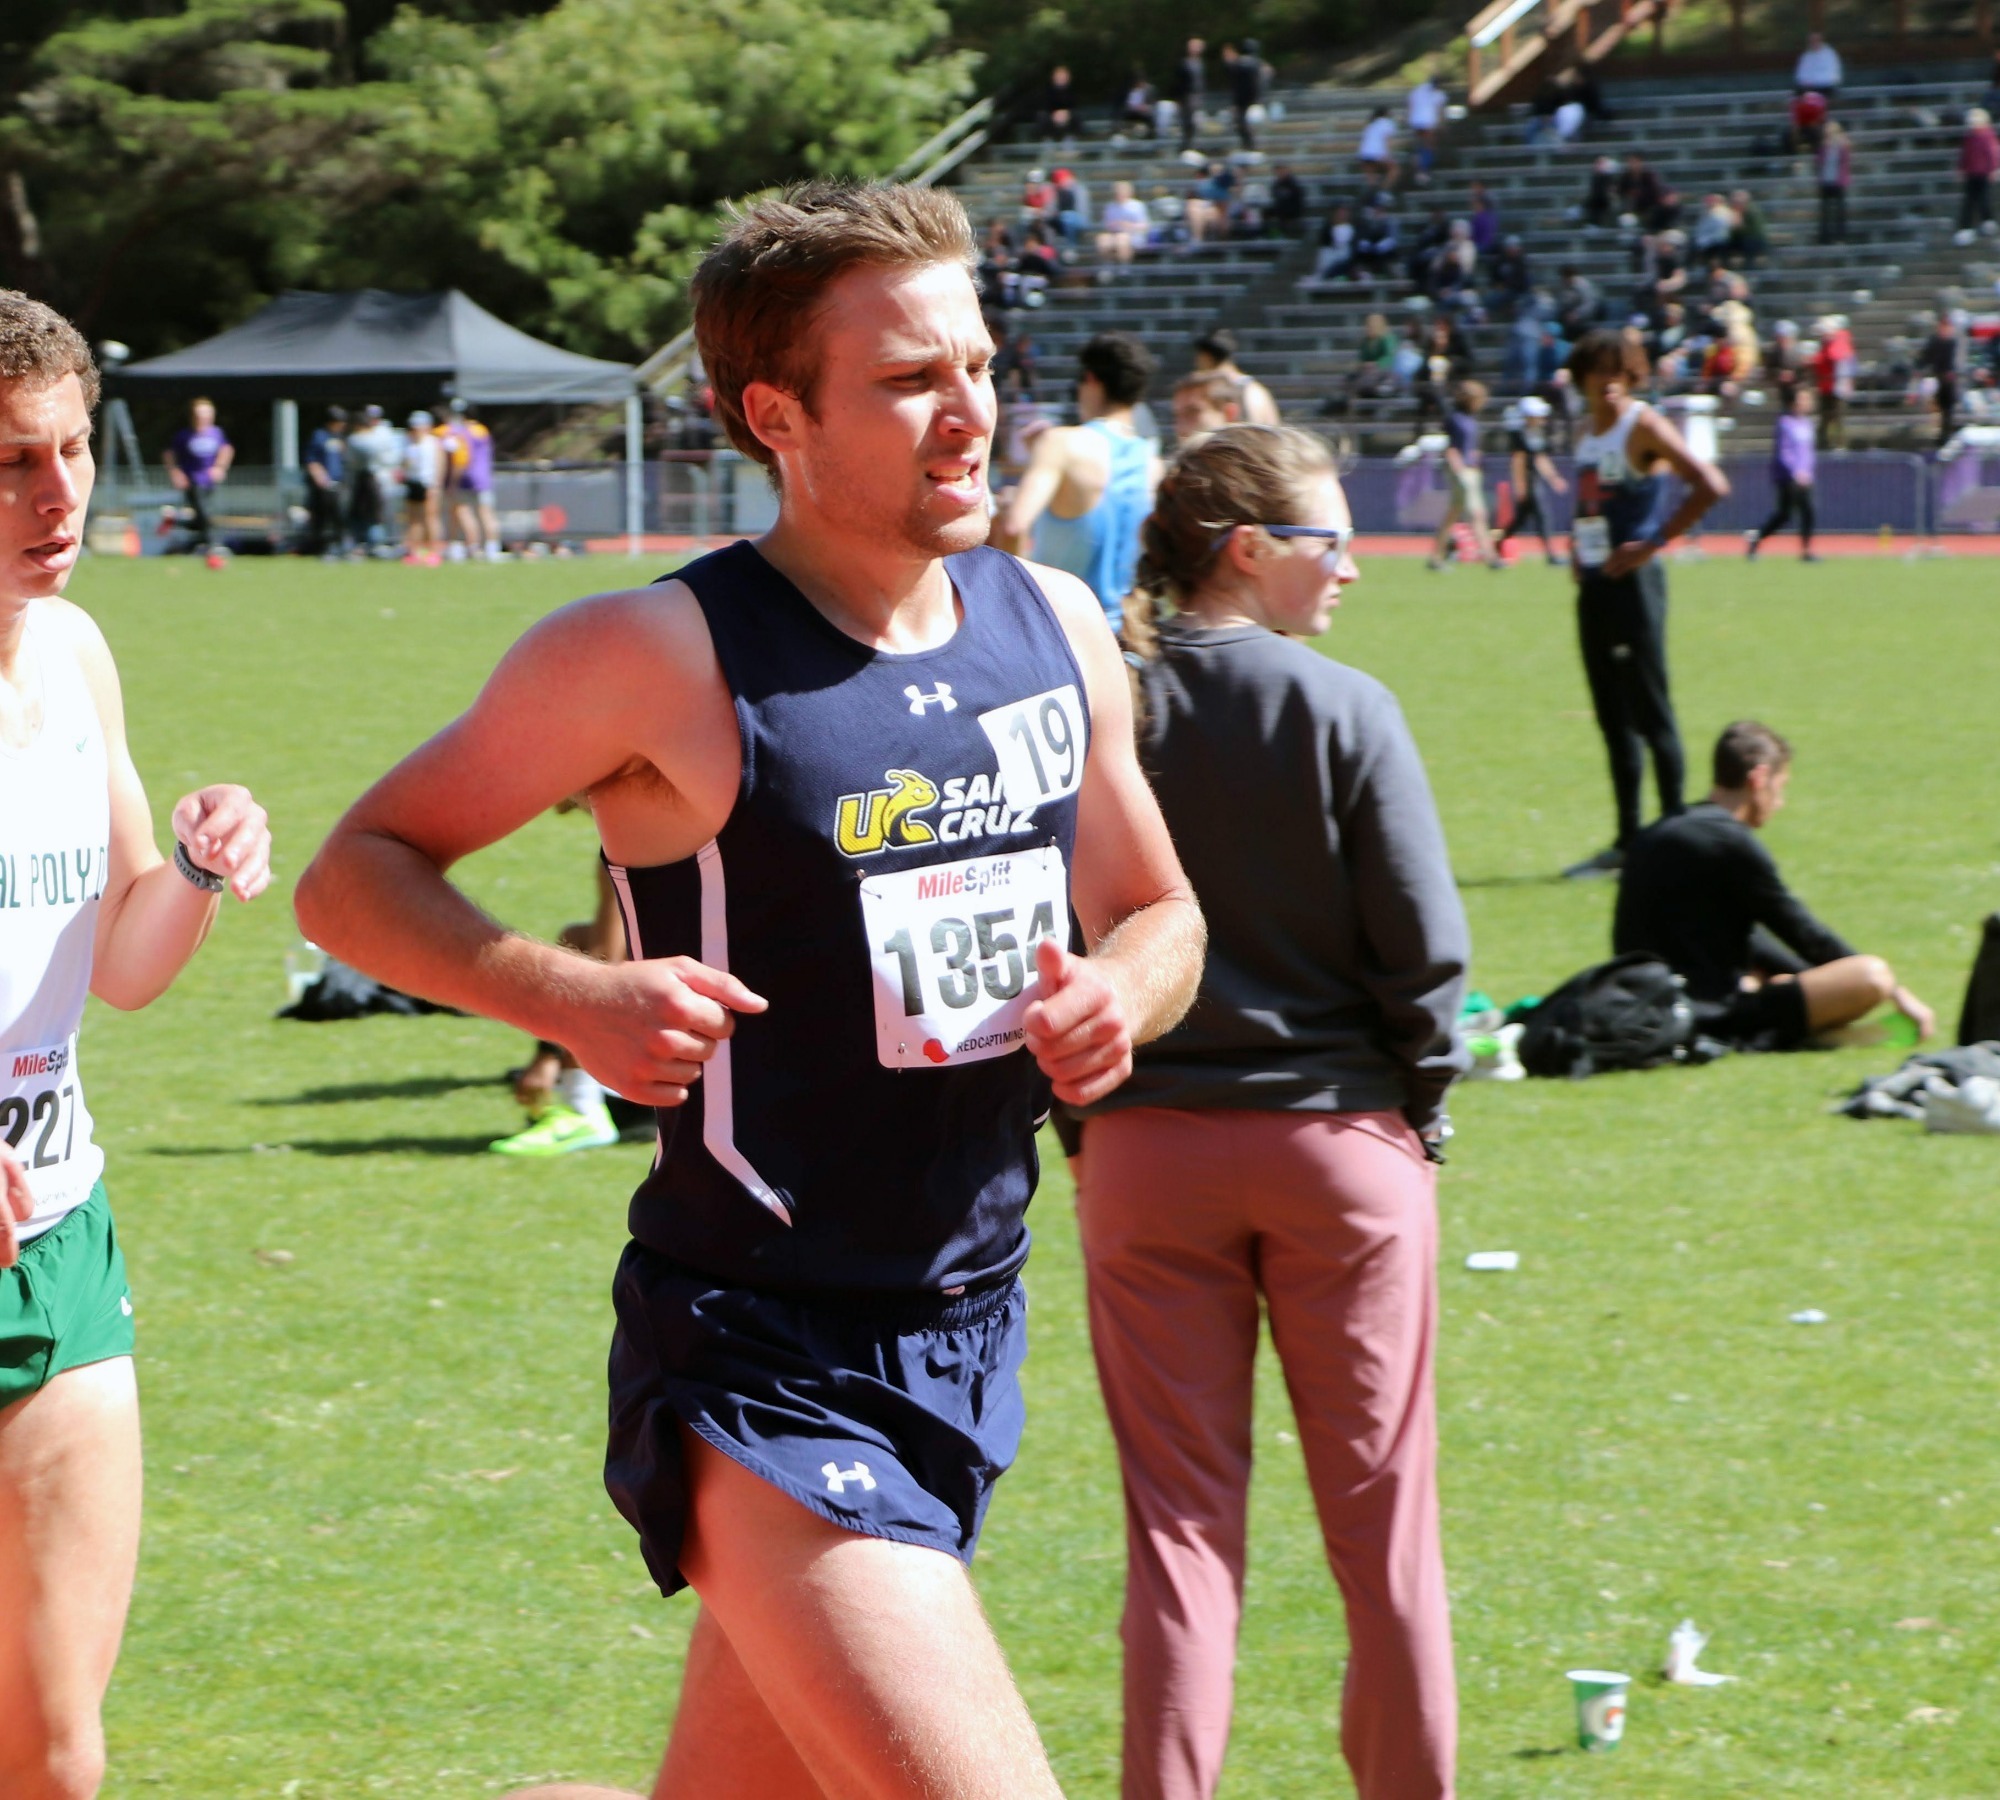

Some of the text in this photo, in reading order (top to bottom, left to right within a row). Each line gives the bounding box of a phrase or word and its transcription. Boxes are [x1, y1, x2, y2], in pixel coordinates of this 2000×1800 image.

[1008, 696, 1075, 796] 19
[940, 770, 1006, 811] SA
[938, 803, 1036, 844] CRUZ
[31, 847, 92, 905] POLY
[917, 860, 1012, 901] MileSplit
[956, 1027, 1027, 1053] REDCAPTIMING.
